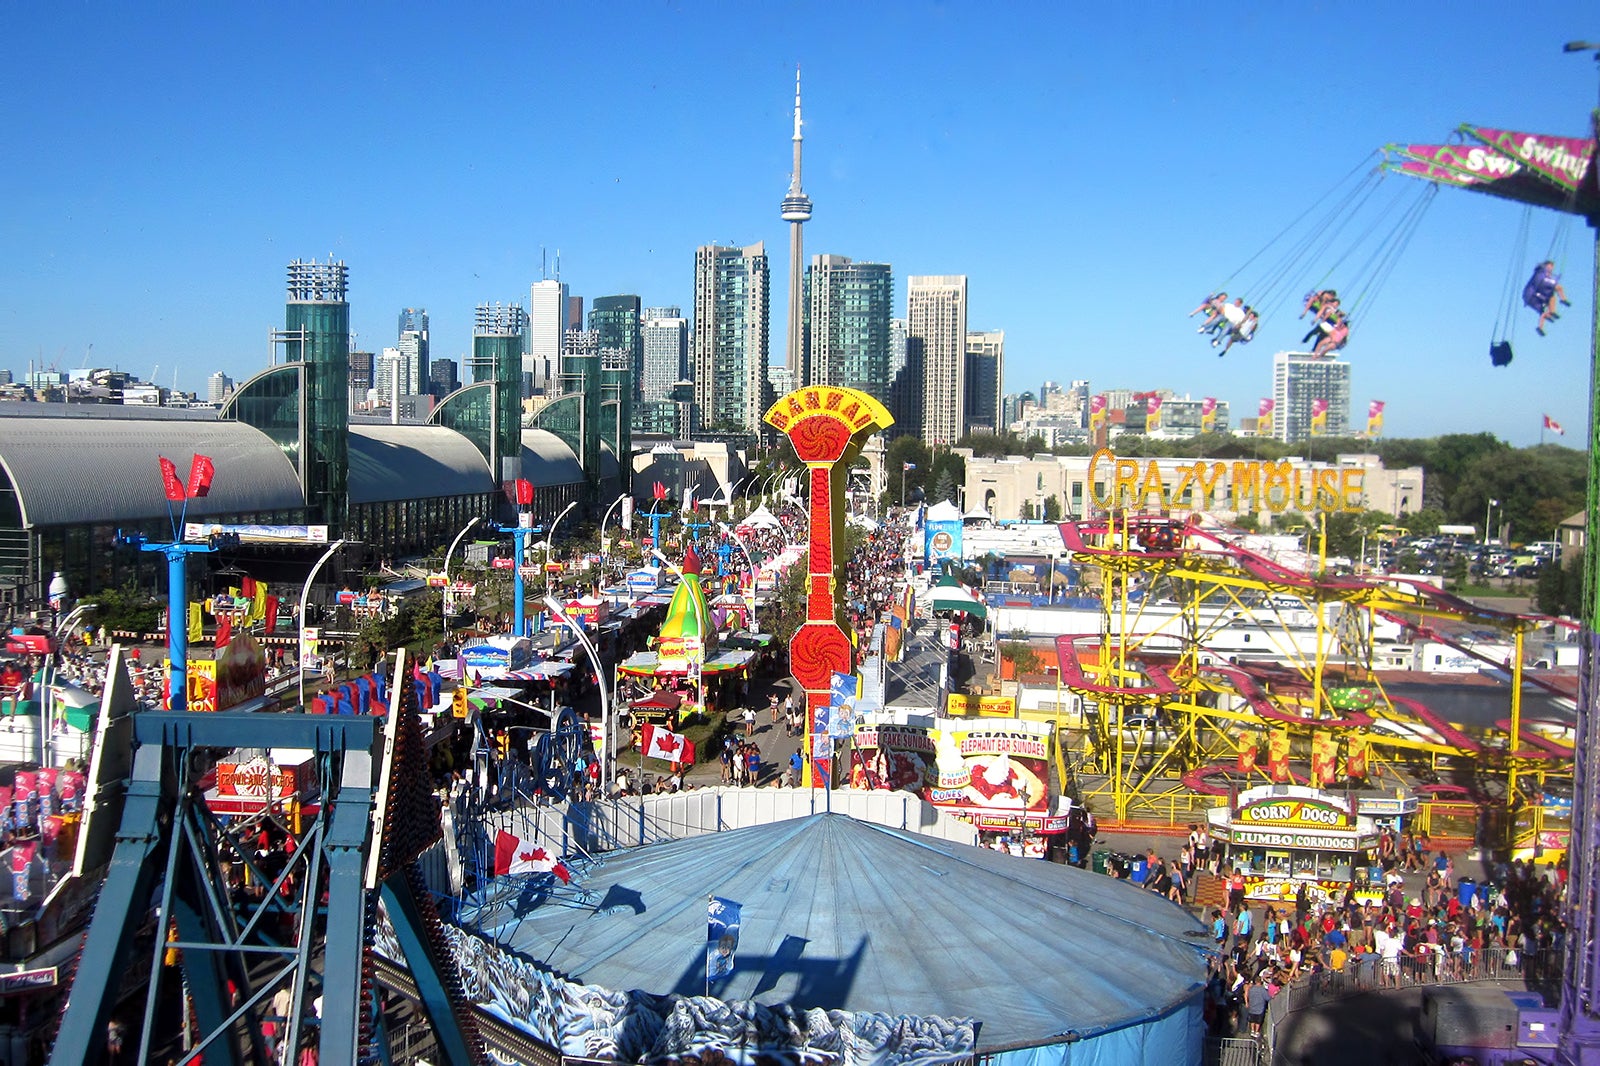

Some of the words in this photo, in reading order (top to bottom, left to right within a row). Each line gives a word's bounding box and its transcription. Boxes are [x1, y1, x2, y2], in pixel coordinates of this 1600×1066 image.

[1088, 447, 1227, 511] CRAZY
[1231, 461, 1366, 512] MOUSE
[858, 726, 928, 736] GIANT
[967, 732, 1042, 741] GIANT
[883, 733, 901, 746] CAKE
[903, 734, 936, 751] SUNDAES
[960, 739, 995, 753] ELEPHANT
[997, 739, 1010, 752] EAR
[1013, 740, 1045, 756] SUNDAES
[221, 772, 247, 786] CROWN
[248, 773, 263, 785] AND
[268, 774, 294, 788] NCHOR
[941, 775, 969, 786] CREAM
[932, 789, 962, 800] CONES
[982, 816, 1007, 826] ELEPHANT
[1250, 805, 1291, 820] CORN
[1301, 807, 1339, 825] DOGS
[1236, 832, 1293, 846] JUMBO
[1296, 837, 1354, 849] CORNDOGS
